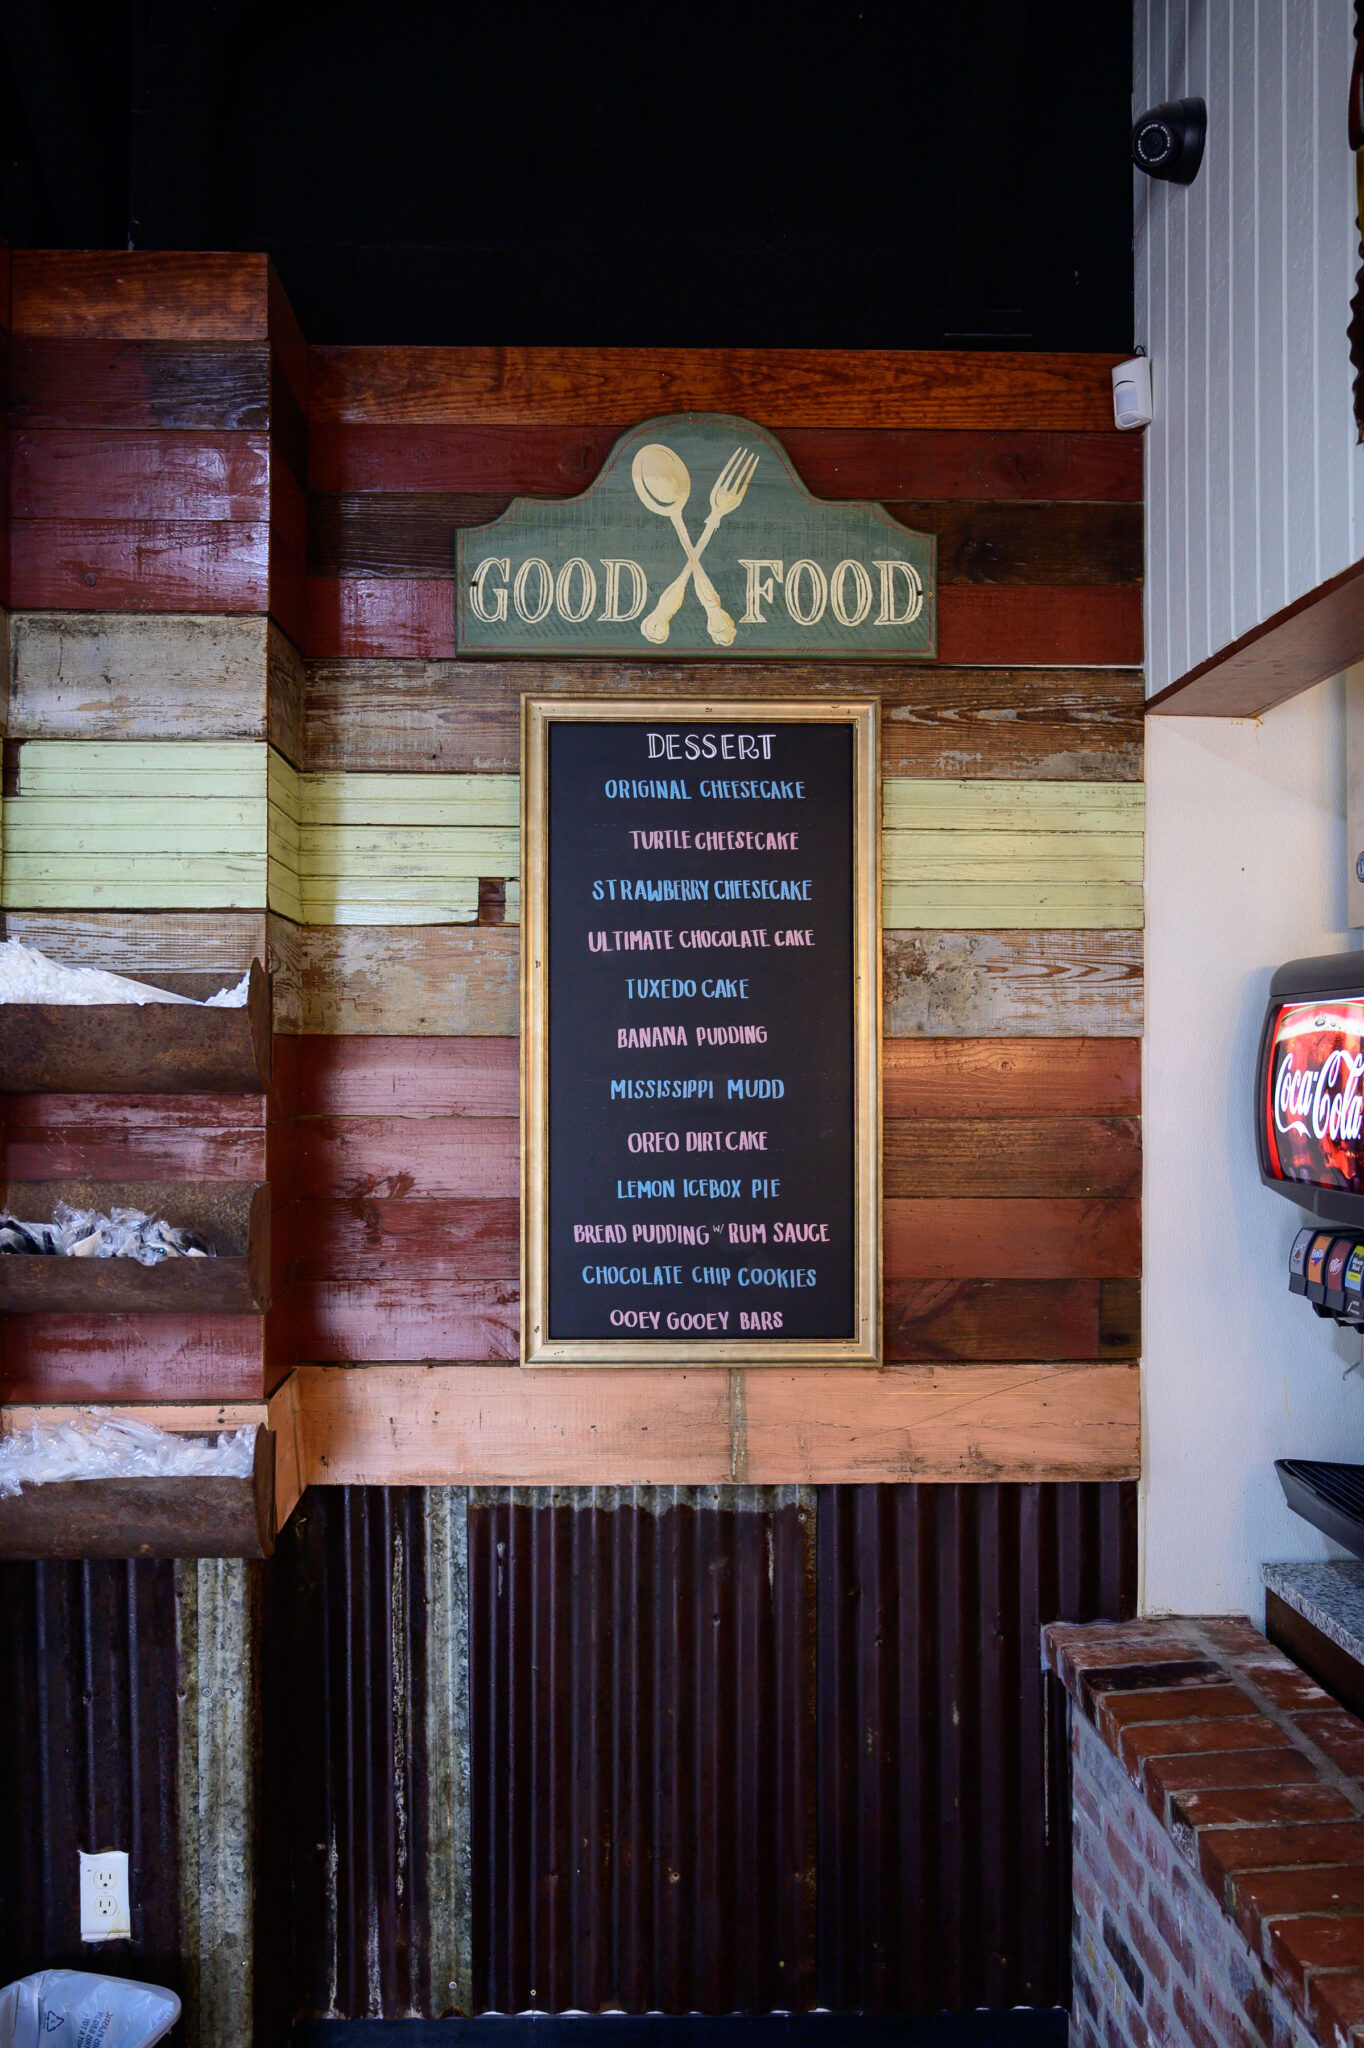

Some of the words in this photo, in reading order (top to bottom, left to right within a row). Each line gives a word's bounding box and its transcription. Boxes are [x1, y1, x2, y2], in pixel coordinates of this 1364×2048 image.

[469, 556, 648, 624] GOOD
[738, 558, 923, 627] FOOD
[647, 733, 776, 760] DESSERT
[605, 780, 692, 799] ORIGINAL
[700, 780, 805, 799] CHEESECAKE
[629, 830, 691, 849] TURTLE
[695, 831, 798, 851] CHEESECAKE
[592, 879, 709, 902] STRAWBERRY
[714, 880, 812, 900] CHEESECAKE
[588, 930, 674, 952] ULTIMATE
[679, 929, 770, 948] CHOCOLATE
[775, 930, 815, 946] CAKE
[625, 978, 696, 999] TUXEDO
[701, 979, 749, 999] CAKE
[618, 1026, 687, 1048] BANANA
[696, 1025, 767, 1046] PUDDING
[611, 1080, 713, 1100] MISSISSIPPI
[728, 1079, 784, 1099] MUDD
[1274, 1049, 1364, 1140] Coca-Cola
[628, 1132, 679, 1153] OREO
[686, 1132, 723, 1152] DIRT
[725, 1131, 768, 1150] CAKE
[618, 1179, 675, 1199] LEMON
[683, 1179, 741, 1199] ICEBOX
[752, 1179, 780, 1198] PIE
[574, 1224, 627, 1243] BREAD
[632, 1224, 709, 1245] PUDDING
[729, 1223, 766, 1243] RUM
[773, 1222, 830, 1243] SAUCE
[582, 1266, 683, 1285] CHOCOLATE
[692, 1266, 731, 1286] CHIP
[738, 1268, 816, 1288] COOKIES
[610, 1310, 660, 1329] OOEY
[667, 1311, 729, 1330] GOOEY
[740, 1312, 783, 1330] BARS
